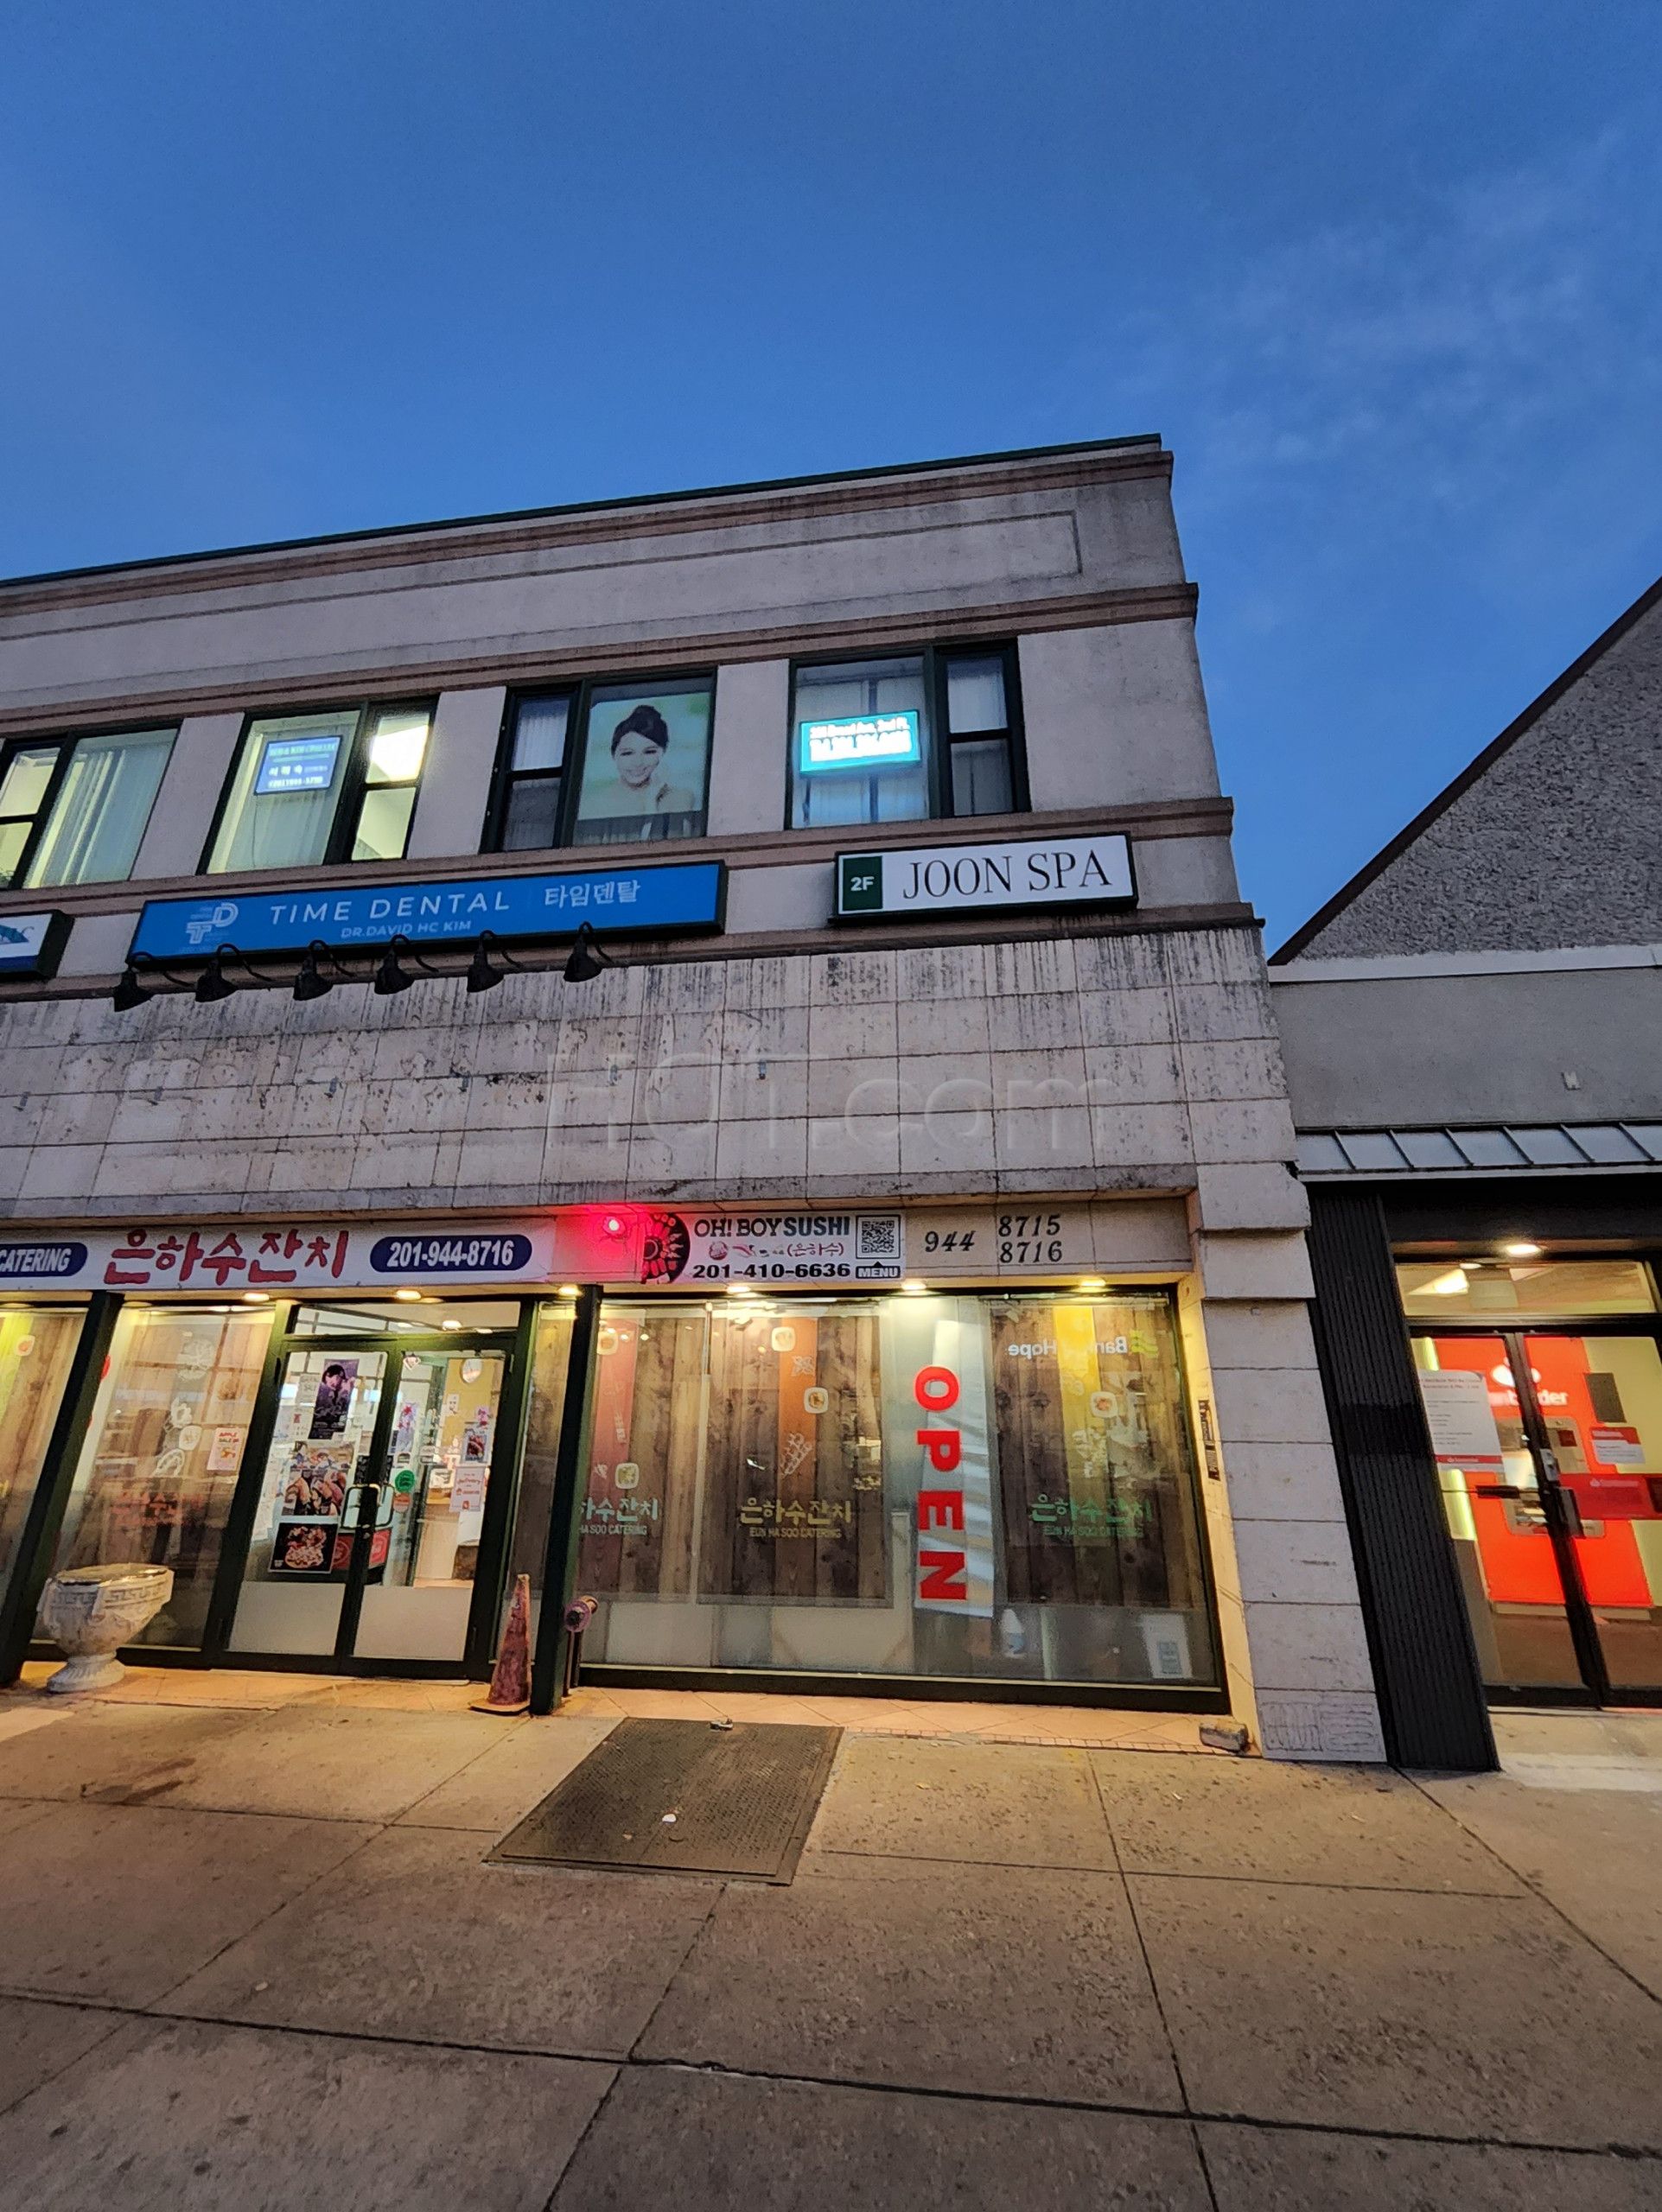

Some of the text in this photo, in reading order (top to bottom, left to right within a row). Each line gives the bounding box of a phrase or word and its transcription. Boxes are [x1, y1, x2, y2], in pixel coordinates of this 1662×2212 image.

[850, 849, 1112, 899] 2F JOON SPA
[270, 880, 641, 925] TIME DENTAL 타임덴탈
[417, 921, 439, 935] HC
[443, 919, 472, 933] KIM
[694, 1217, 732, 1237] OH!
[998, 1213, 1061, 1237] 8715
[386, 1239, 514, 1268] 201-944-8716
[787, 1242, 845, 1257] (은하수)
[925, 1230, 977, 1253] 944
[999, 1240, 1063, 1263] 8716
[0, 1248, 72, 1273] CATERING
[103, 1228, 349, 1286] 은하수잔치
[692, 1262, 851, 1280] 201-410-6636
[858, 1268, 898, 1279] MENU
[914, 1365, 967, 1600] OPEN
[740, 1497, 852, 1526] 은하수잔치
